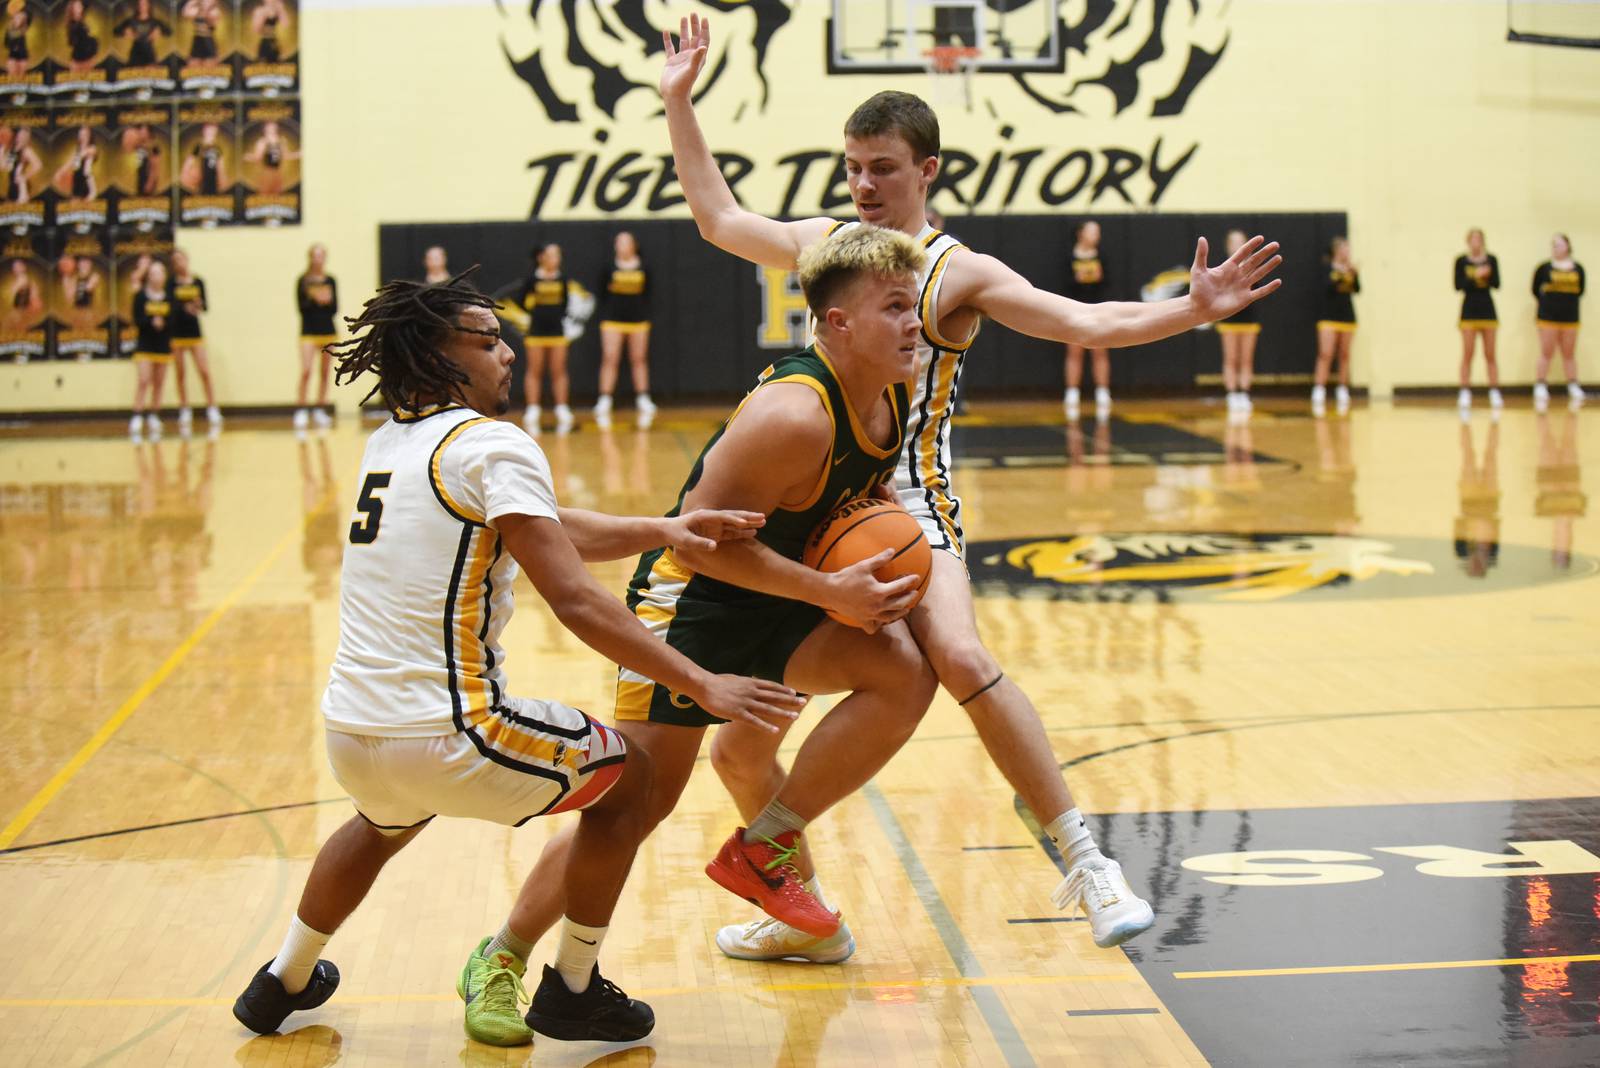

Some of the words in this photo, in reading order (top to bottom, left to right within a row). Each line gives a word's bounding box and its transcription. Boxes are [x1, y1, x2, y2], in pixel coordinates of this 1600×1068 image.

[526, 128, 755, 220] TIGER
[777, 125, 1199, 217] TERITORY
[348, 471, 393, 545] 5
